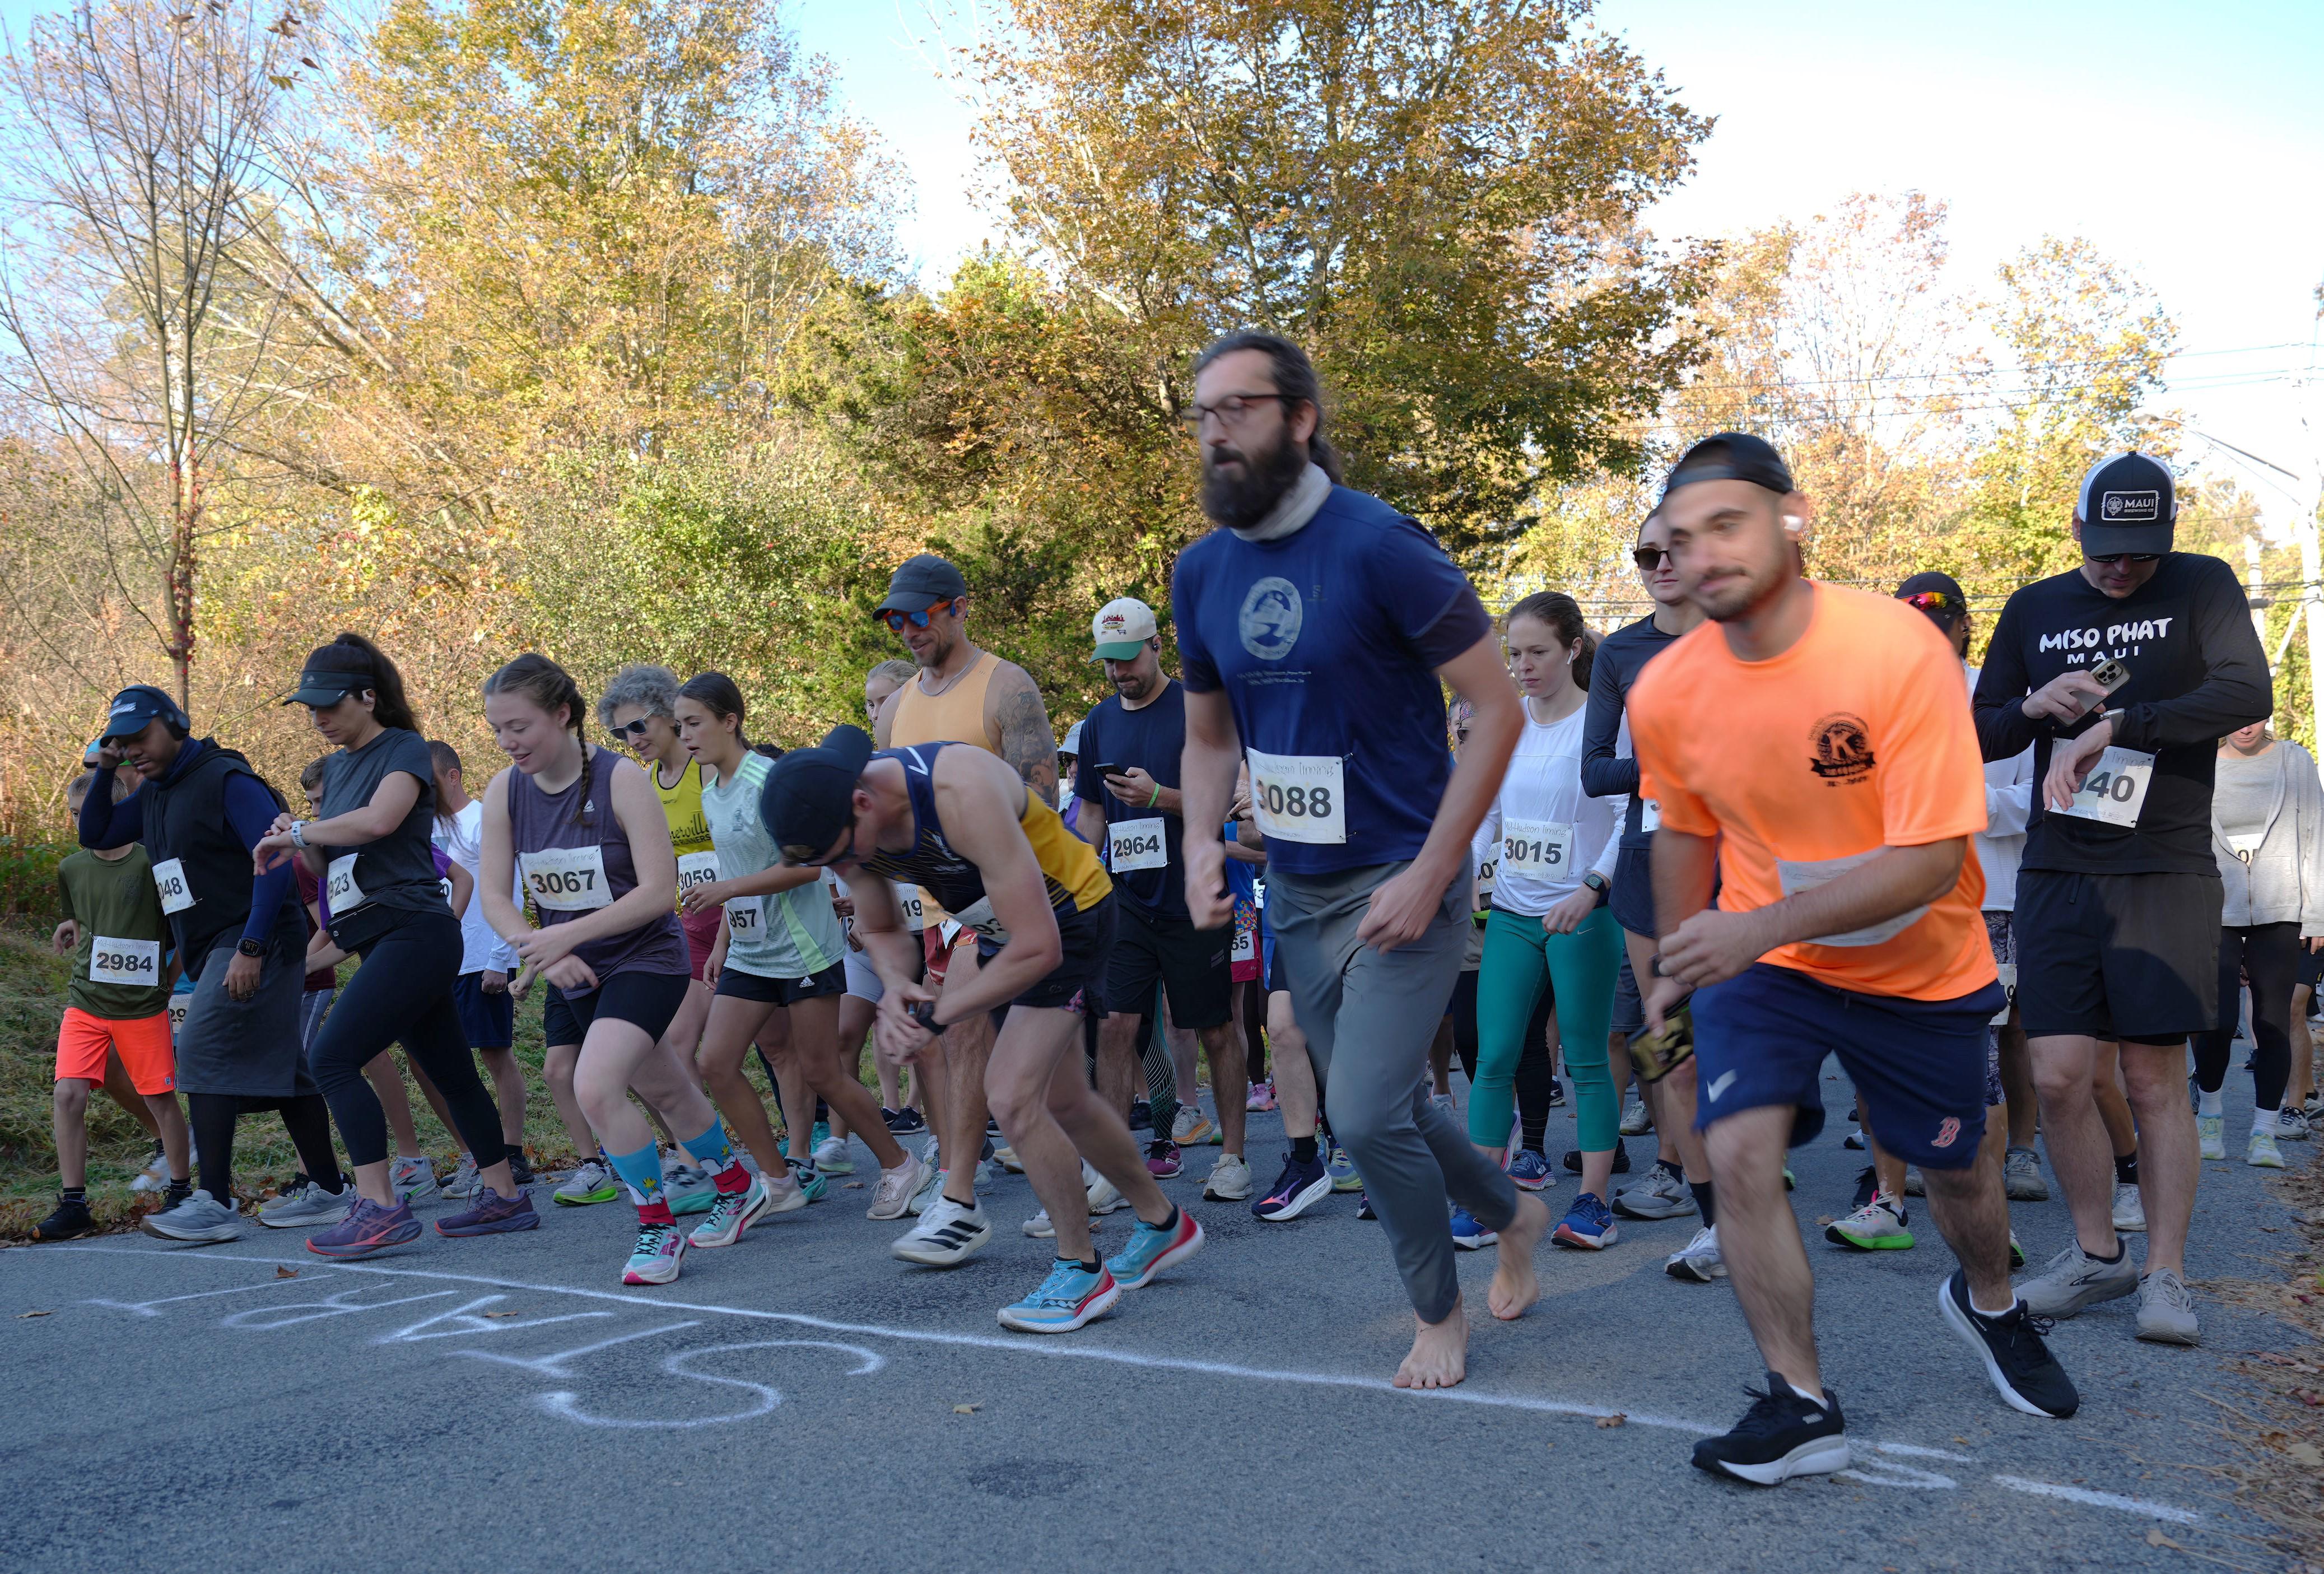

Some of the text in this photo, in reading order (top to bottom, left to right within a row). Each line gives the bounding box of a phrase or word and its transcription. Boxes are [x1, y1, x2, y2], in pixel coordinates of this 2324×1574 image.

[2124, 499, 2154, 509] MAUI
[2039, 617, 2173, 654] MISO PHAT
[2067, 645, 2139, 664] MAUI
[2111, 751, 2146, 770] Timing
[1504, 821, 1567, 837] Mid-Hudson Timing
[1113, 835, 1160, 858] 2964
[1504, 838, 1562, 865] 3015
[530, 869, 595, 894] 3067
[96, 939, 155, 951] Mid-Hudson Timing
[96, 952, 153, 972] 2984
[78, 1274, 887, 1429] START
